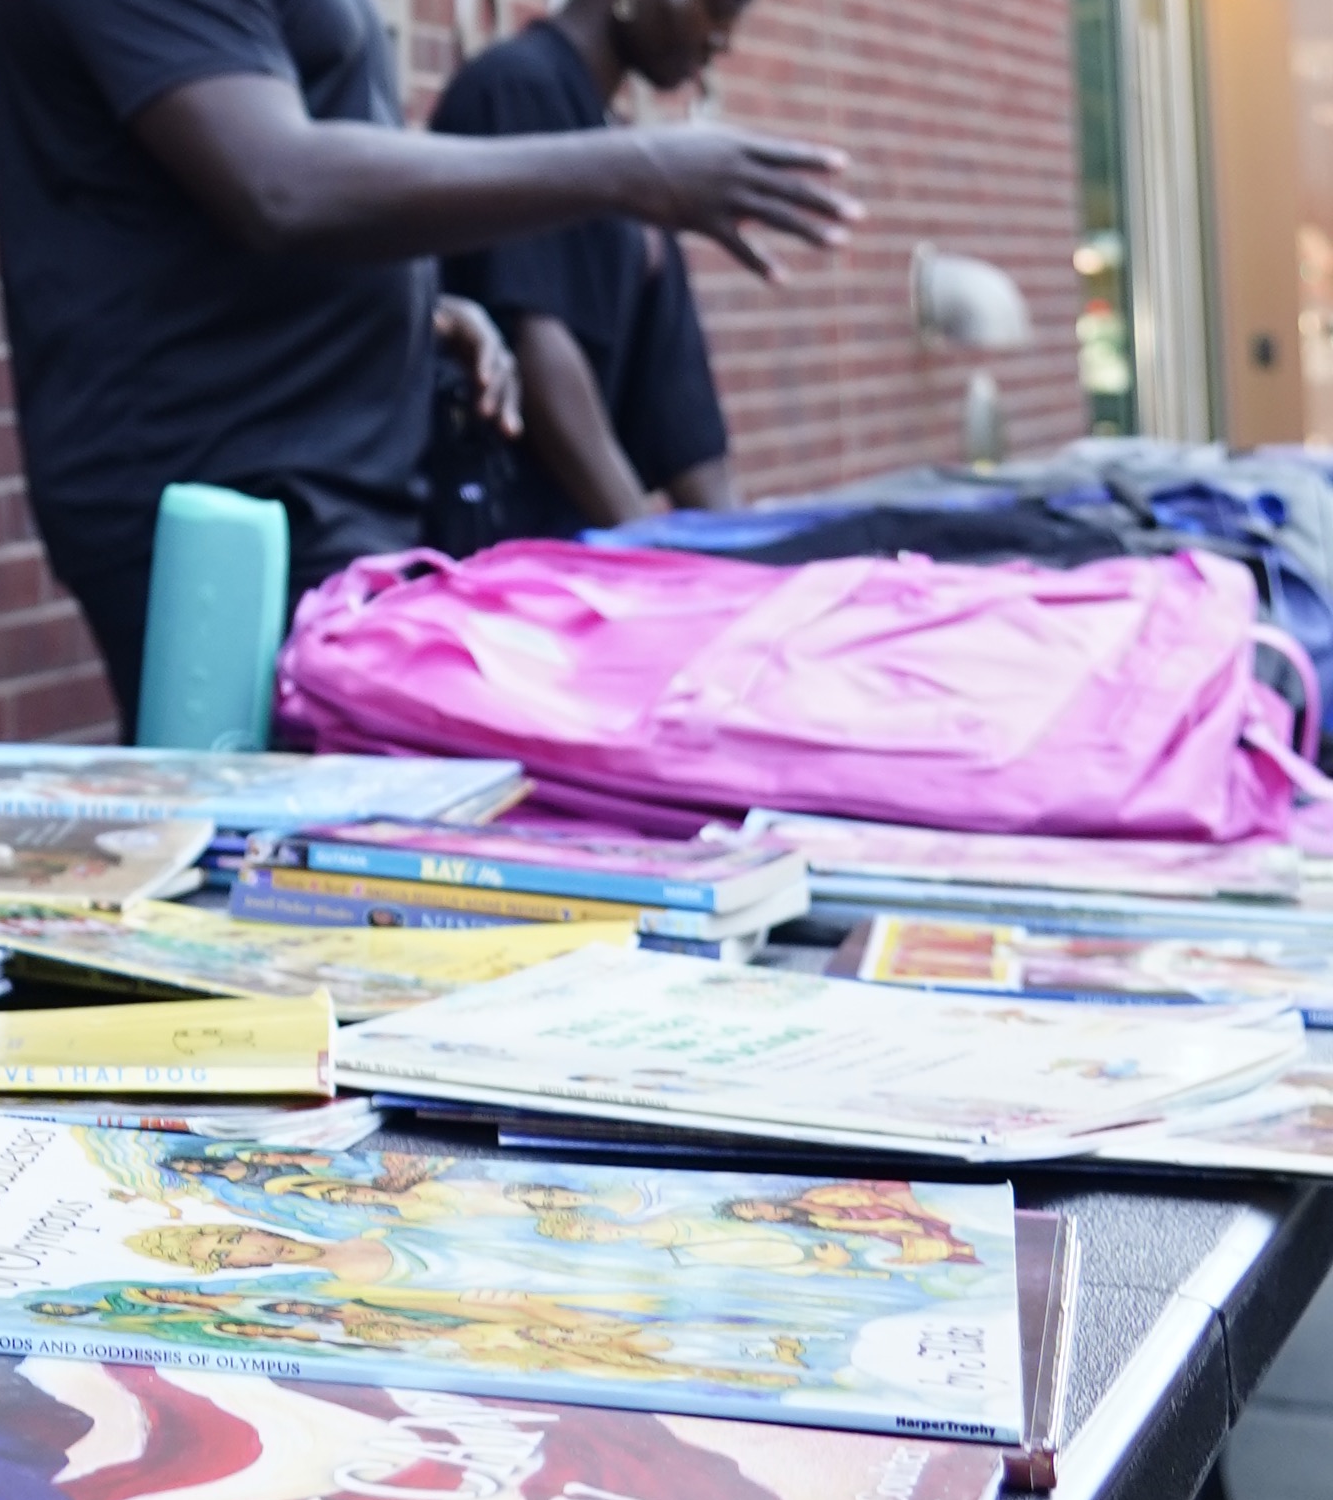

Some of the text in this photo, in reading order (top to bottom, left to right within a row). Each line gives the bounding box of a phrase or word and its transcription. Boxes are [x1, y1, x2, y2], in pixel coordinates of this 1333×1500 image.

[56, 1066, 116, 1083] THAT
[145, 1066, 209, 1084] DOG
[38, 1339, 77, 1356] AND
[82, 1342, 183, 1366] GODDESSES
[187, 1351, 211, 1367] OF
[216, 1354, 302, 1376] OLYMPUS
[895, 1416, 997, 1438] HarperTrophy
